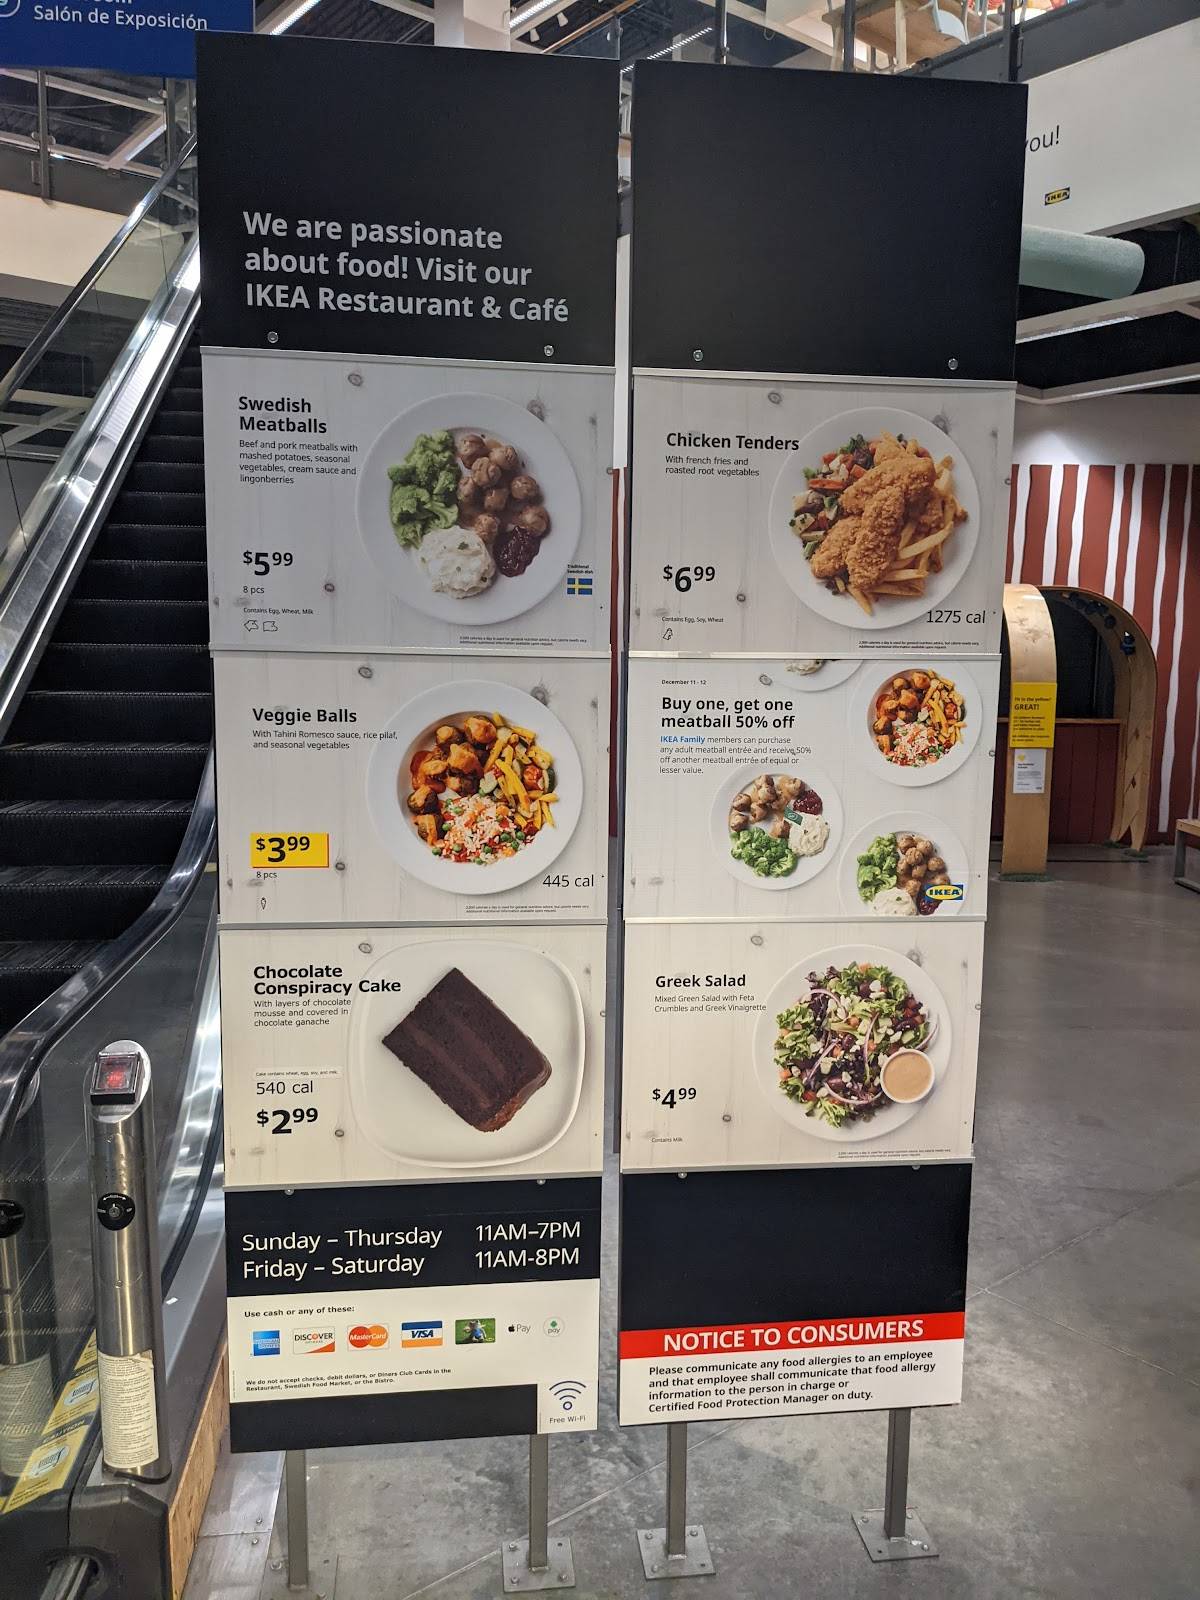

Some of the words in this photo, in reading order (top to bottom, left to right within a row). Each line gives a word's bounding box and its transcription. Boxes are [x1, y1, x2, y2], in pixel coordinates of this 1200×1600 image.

[34, 5, 82, 23] Salón
[88, 8, 110, 24] de
[115, 10, 208, 31] Exposición
[243, 211, 288, 237] We
[296, 219, 342, 240] are
[351, 220, 503, 250] passionate
[245, 247, 329, 275] about
[337, 252, 408, 280] food!
[415, 257, 477, 283] Visit
[485, 266, 533, 286] our
[246, 283, 310, 309] IKEA
[318, 287, 474, 317] Restaurant
[481, 295, 502, 319] &
[509, 297, 569, 322] Café
[238, 396, 312, 413] Swedish
[239, 416, 327, 434] Meatballs
[239, 439, 258, 448] Beef
[260, 441, 276, 449] and
[278, 441, 297, 451] pork
[299, 443, 339, 452] meatballs
[340, 444, 358, 452] with
[666, 432, 731, 449] Chicken
[736, 435, 800, 451] Tenders
[665, 455, 684, 464] With
[686, 455, 712, 465] french
[714, 456, 732, 465] fries
[733, 458, 749, 466] and
[665, 466, 696, 475] roasted
[698, 467, 714, 475] root
[717, 468, 760, 477] vegetables
[240, 474, 294, 484] lingonberries
[242, 585, 249, 594] 8
[250, 587, 265, 595] pcs
[926, 610, 961, 624] 1275
[965, 610, 986, 624] cal
[662, 697, 692, 713] Buy
[696, 699, 729, 712] one,
[734, 698, 760, 714] get
[764, 700, 793, 711] one
[1014, 703, 1040, 711] GREAT!
[252, 708, 312, 726] Veggie
[317, 708, 357, 723] Balls
[661, 715, 731, 728] meatball
[735, 715, 768, 729] 50%
[772, 716, 796, 729] off
[252, 730, 272, 738] With
[273, 730, 297, 738] Tahini
[299, 730, 335, 739] Romesco
[336, 732, 361, 740] sauce,
[363, 731, 378, 739] rice
[379, 731, 398, 741] pilaf,
[680, 736, 706, 745] Family
[707, 736, 742, 744] members
[758, 737, 791, 745] purchase
[252, 741, 269, 749] and
[270, 741, 305, 749] seasonal
[307, 741, 350, 750] vegetables
[263, 872, 278, 880] pcs
[543, 874, 570, 887] 445
[574, 874, 594, 887] cal
[253, 965, 343, 979] Chocolate
[254, 981, 352, 997] Conspiracy
[358, 979, 401, 992] Cake
[655, 974, 701, 988] Greek
[705, 974, 746, 987] Salad
[275, 999, 300, 1009] layers
[313, 998, 351, 1006] chocolate
[654, 995, 677, 1003] Mixed
[701, 994, 721, 1002] Salad
[654, 1004, 688, 1013] Crumbles
[690, 1004, 704, 1012] and
[728, 1003, 767, 1013] Vinaigrette
[254, 1019, 293, 1027] chocolate
[295, 1018, 330, 1028] ganache
[256, 1081, 286, 1095] 540
[292, 1079, 313, 1094] cal
[242, 1231, 321, 1254] Sunday
[344, 1226, 443, 1249] Thursday
[243, 1259, 308, 1281] Friday
[331, 1254, 425, 1276] Saturday
[244, 1310, 261, 1318] Use
[263, 1309, 284, 1317] cash
[298, 1307, 314, 1316] any
[316, 1306, 326, 1314] of
[327, 1305, 355, 1313] these:
[410, 1329, 434, 1339] VISA
[516, 1323, 531, 1333] Pay
[294, 1332, 333, 1342] DISCOVER
[349, 1331, 387, 1341] MasterCard
[664, 1330, 745, 1352] NOTICE
[751, 1328, 781, 1348] TO
[788, 1319, 924, 1345] CONSUMERS
[649, 1366, 683, 1376] Please
[686, 1361, 758, 1373] communicate
[760, 1359, 780, 1370] any
[782, 1357, 806, 1367] food
[808, 1354, 852, 1367] allergies
[854, 1353, 866, 1363] to
[868, 1353, 881, 1362] an
[883, 1350, 933, 1363] employee
[649, 1378, 669, 1388] and
[671, 1376, 695, 1387] that
[697, 1374, 748, 1387] employee
[750, 1371, 775, 1382] shall
[777, 1367, 848, 1380] communicate
[851, 1365, 873, 1376] that
[875, 1364, 899, 1374] food
[901, 1362, 936, 1373] allergy
[648, 1388, 712, 1401] information
[714, 1387, 726, 1396] to
[728, 1385, 746, 1395] the
[748, 1383, 785, 1396] person
[787, 1382, 797, 1392] in
[800, 1381, 836, 1392] charge
[838, 1380, 849, 1388] or
[648, 1400, 695, 1413] Certified
[697, 1399, 723, 1410] Food
[725, 1396, 780, 1408] Protection
[783, 1391, 829, 1404] Manager
[831, 1391, 845, 1400] on
[847, 1390, 873, 1400] duty.
[549, 1416, 566, 1424] Free
[567, 1415, 586, 1423] Wi-Fi
